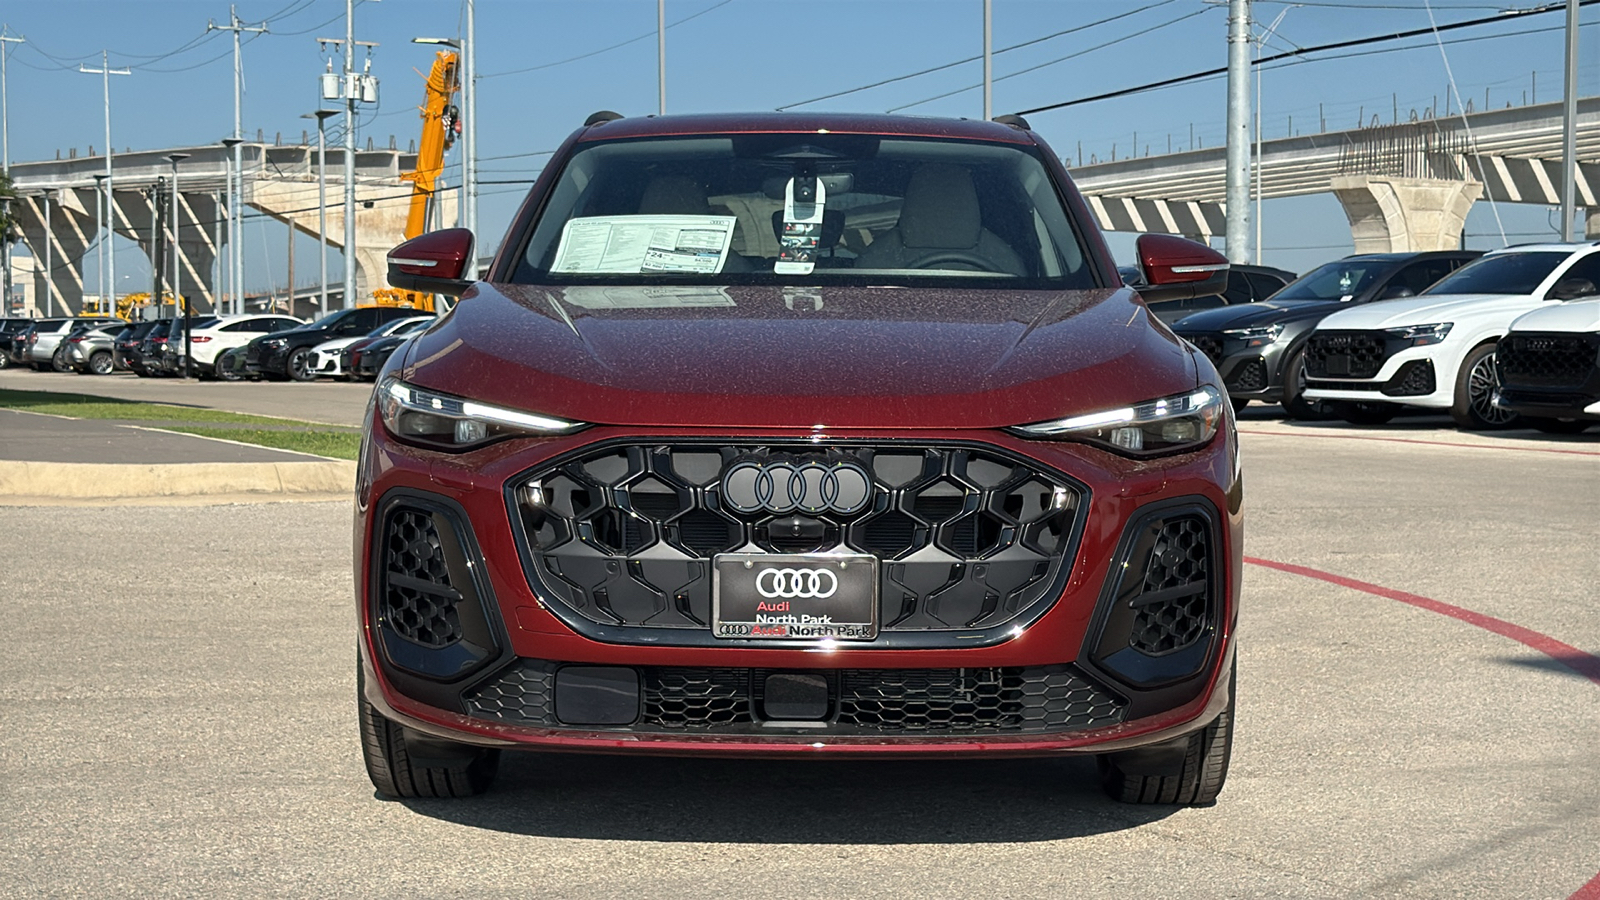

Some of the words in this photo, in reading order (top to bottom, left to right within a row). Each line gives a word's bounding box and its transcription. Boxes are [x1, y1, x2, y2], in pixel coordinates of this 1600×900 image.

[757, 601, 790, 611] Audi
[756, 614, 798, 623] North
[801, 614, 832, 624] Park
[751, 625, 786, 636] Audi
[789, 625, 834, 636] North
[837, 626, 870, 637] Park
